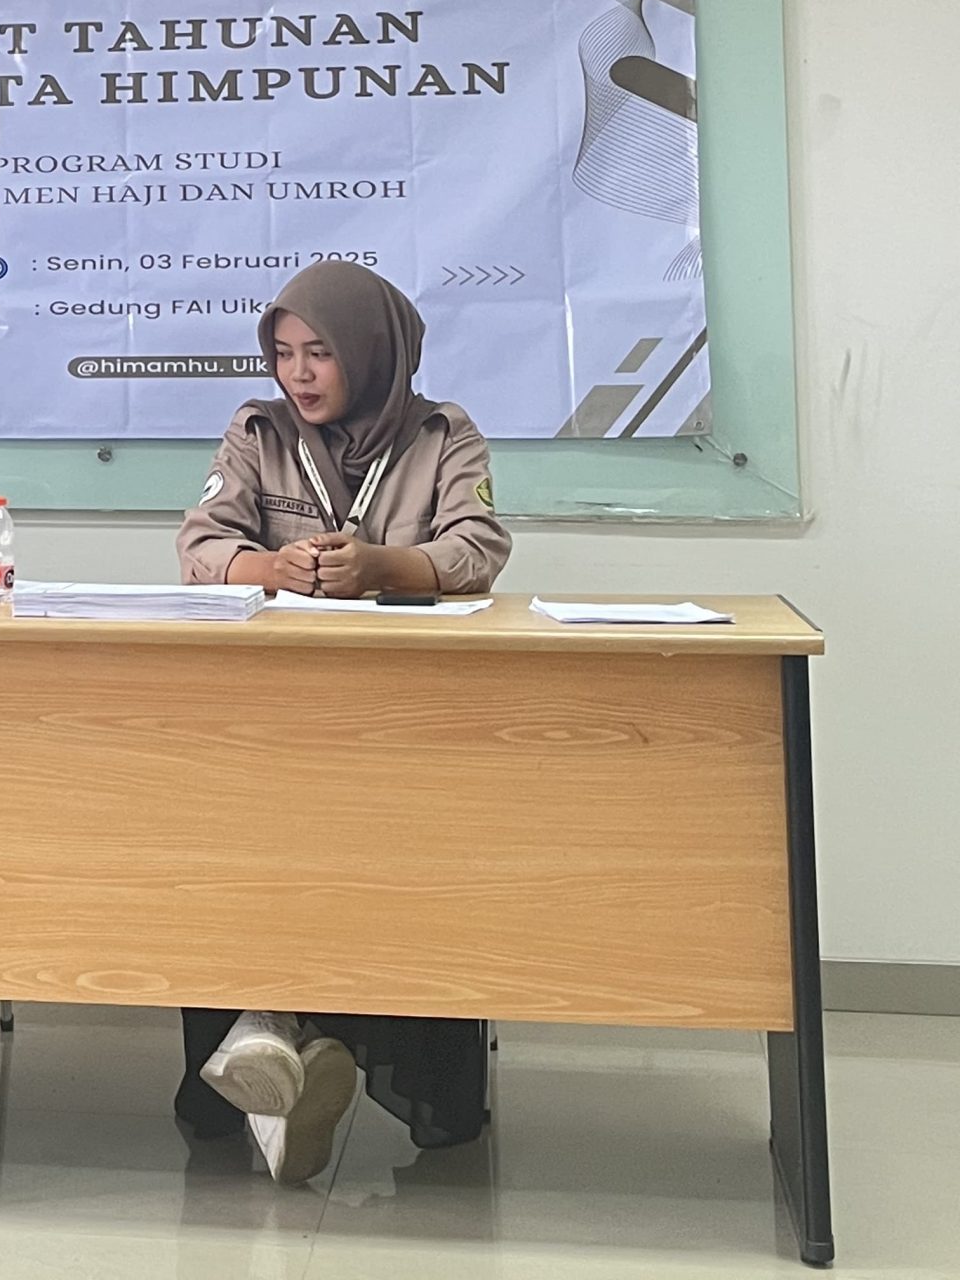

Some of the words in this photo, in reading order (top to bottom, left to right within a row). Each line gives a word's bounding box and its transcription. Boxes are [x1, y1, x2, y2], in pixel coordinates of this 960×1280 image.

[64, 12, 424, 53] TAHUNAN
[100, 62, 511, 104] HIMPUNAN
[175, 151, 282, 170] STUDI
[92, 183, 167, 207] HAJI
[179, 182, 255, 202] DAN
[266, 179, 406, 200] UMROH
[47, 255, 130, 272] Senin,
[140, 254, 172, 270] 03
[182, 251, 300, 270] Februari
[49, 299, 161, 320] Gedung
[172, 300, 211, 315] FAI
[222, 297, 272, 314] Uik
[77, 357, 225, 376] @himamhu.
